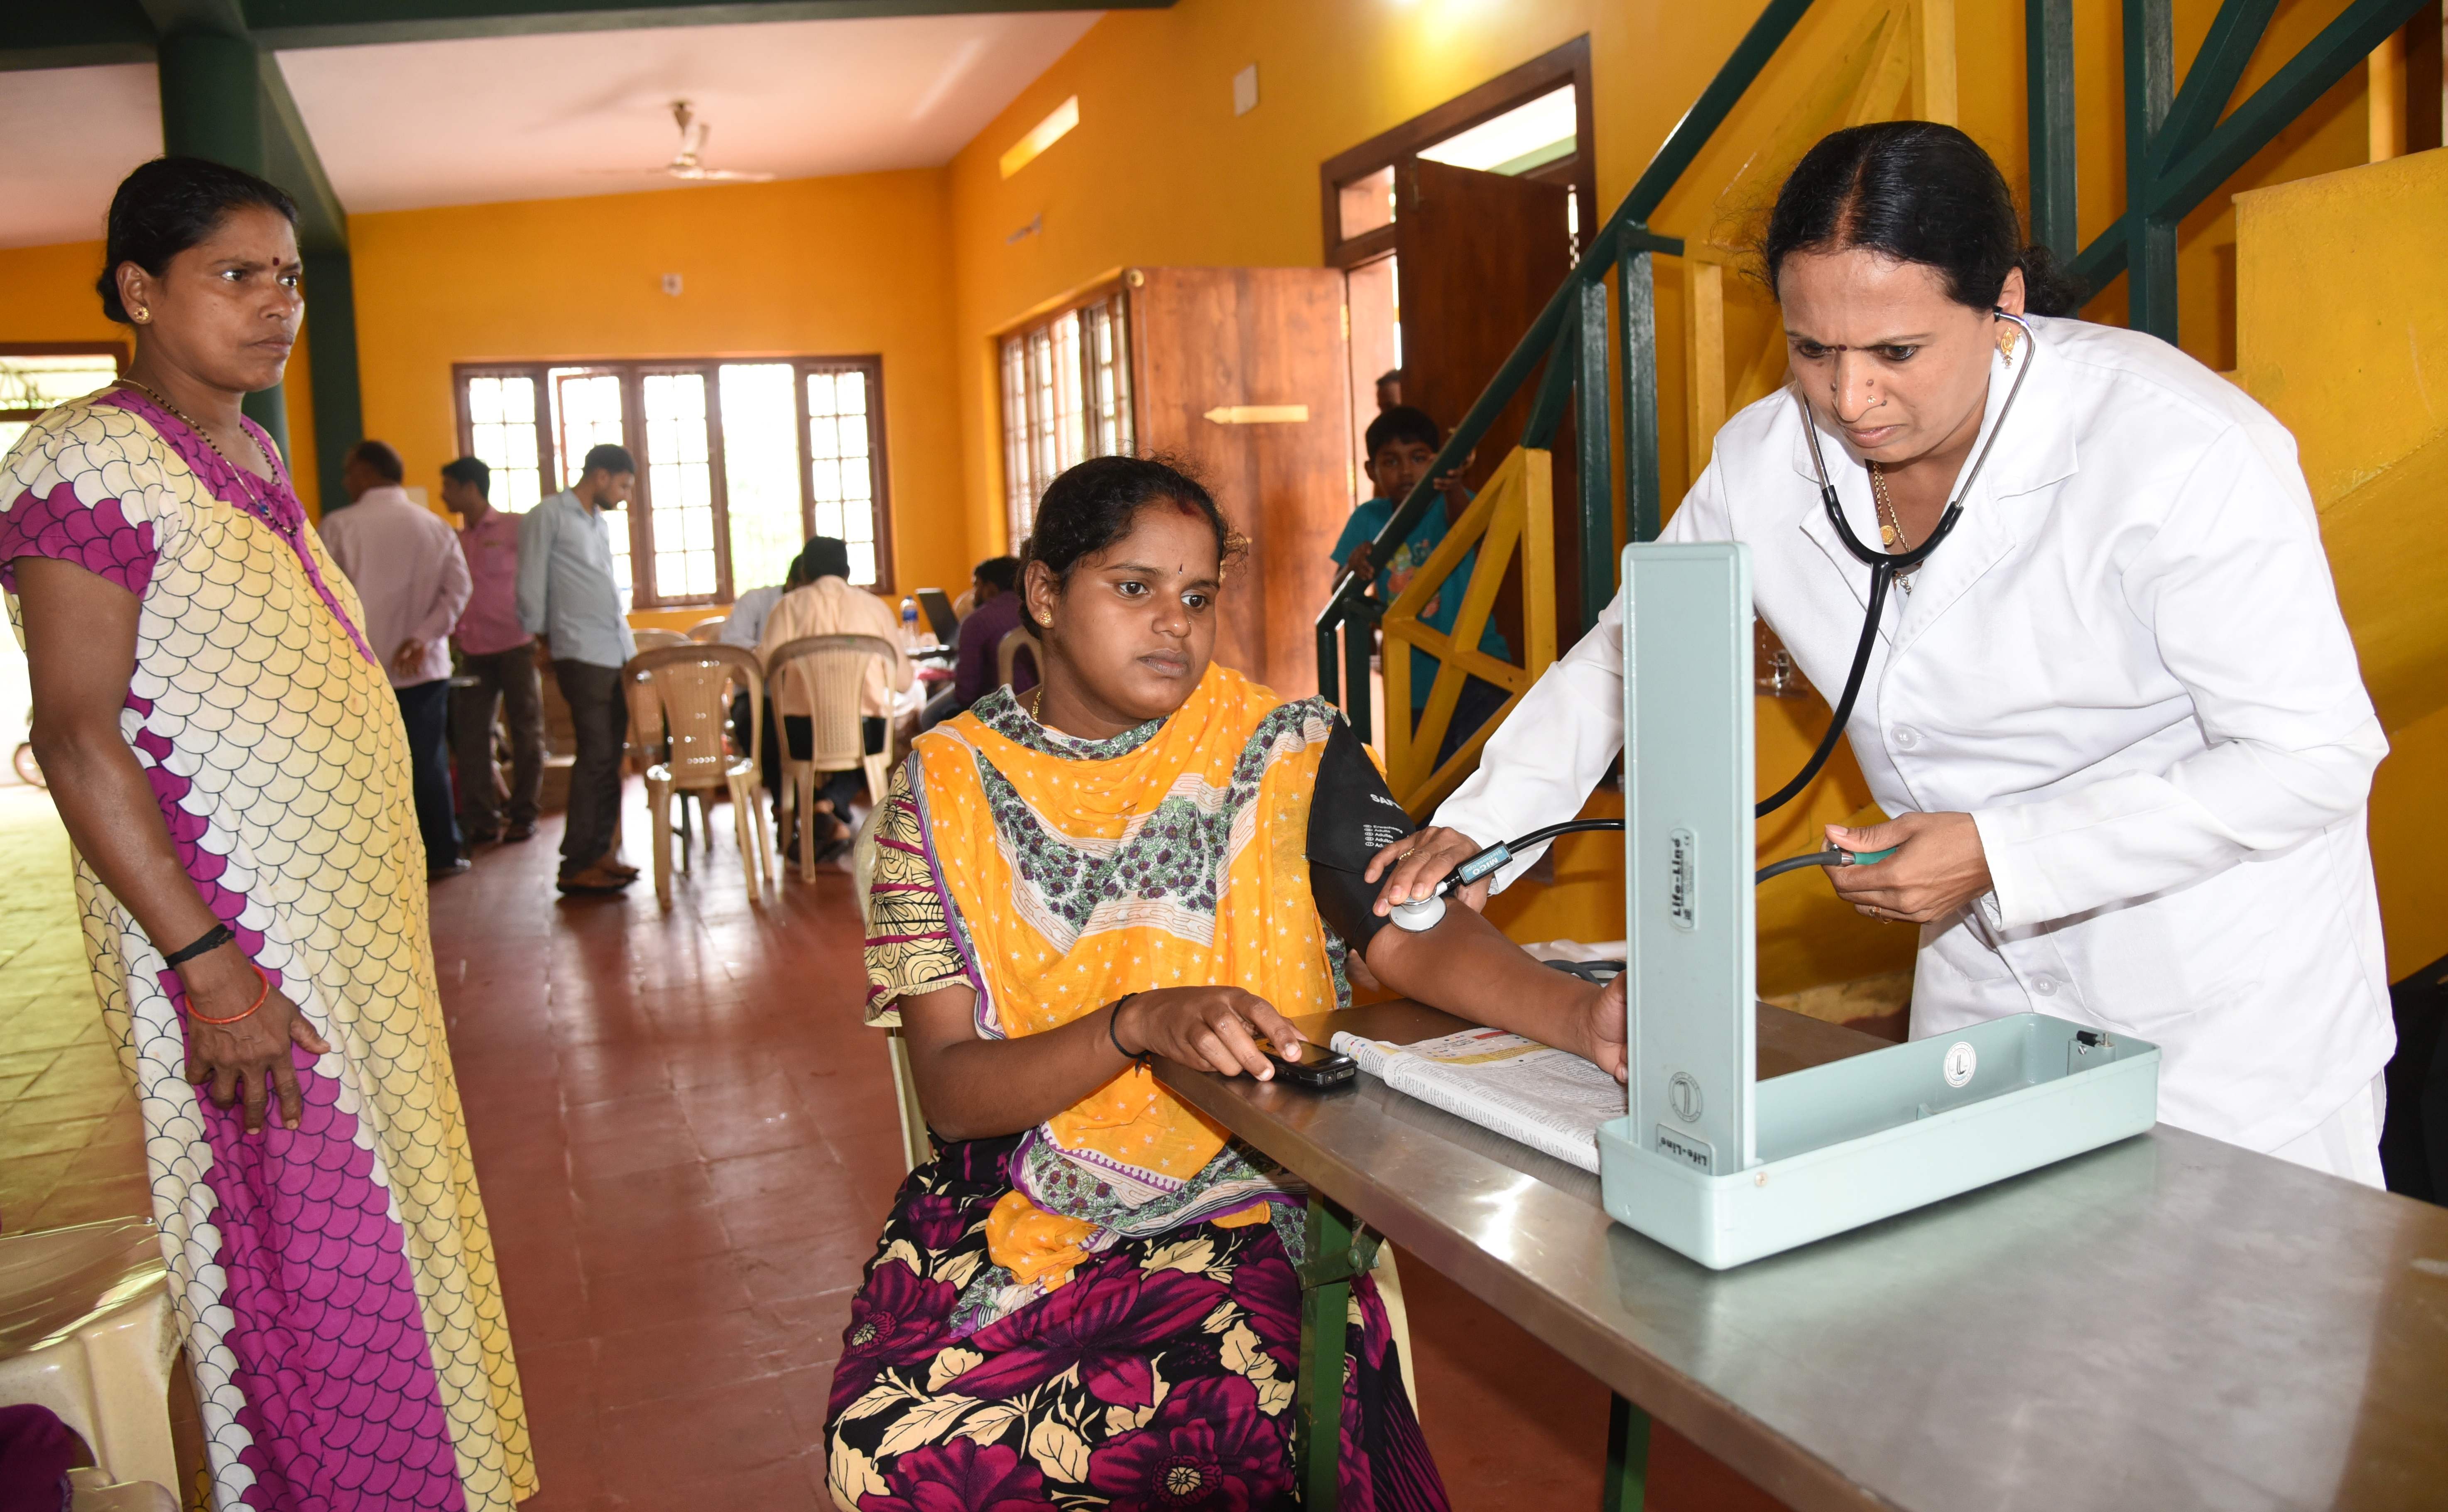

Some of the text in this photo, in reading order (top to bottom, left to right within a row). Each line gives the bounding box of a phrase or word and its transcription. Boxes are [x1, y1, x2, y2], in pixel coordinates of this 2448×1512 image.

[1465, 849, 1502, 873] Stethoscope
[1473, 857, 1498, 875] MICO
[1660, 1137, 1707, 1166] Life-Line
